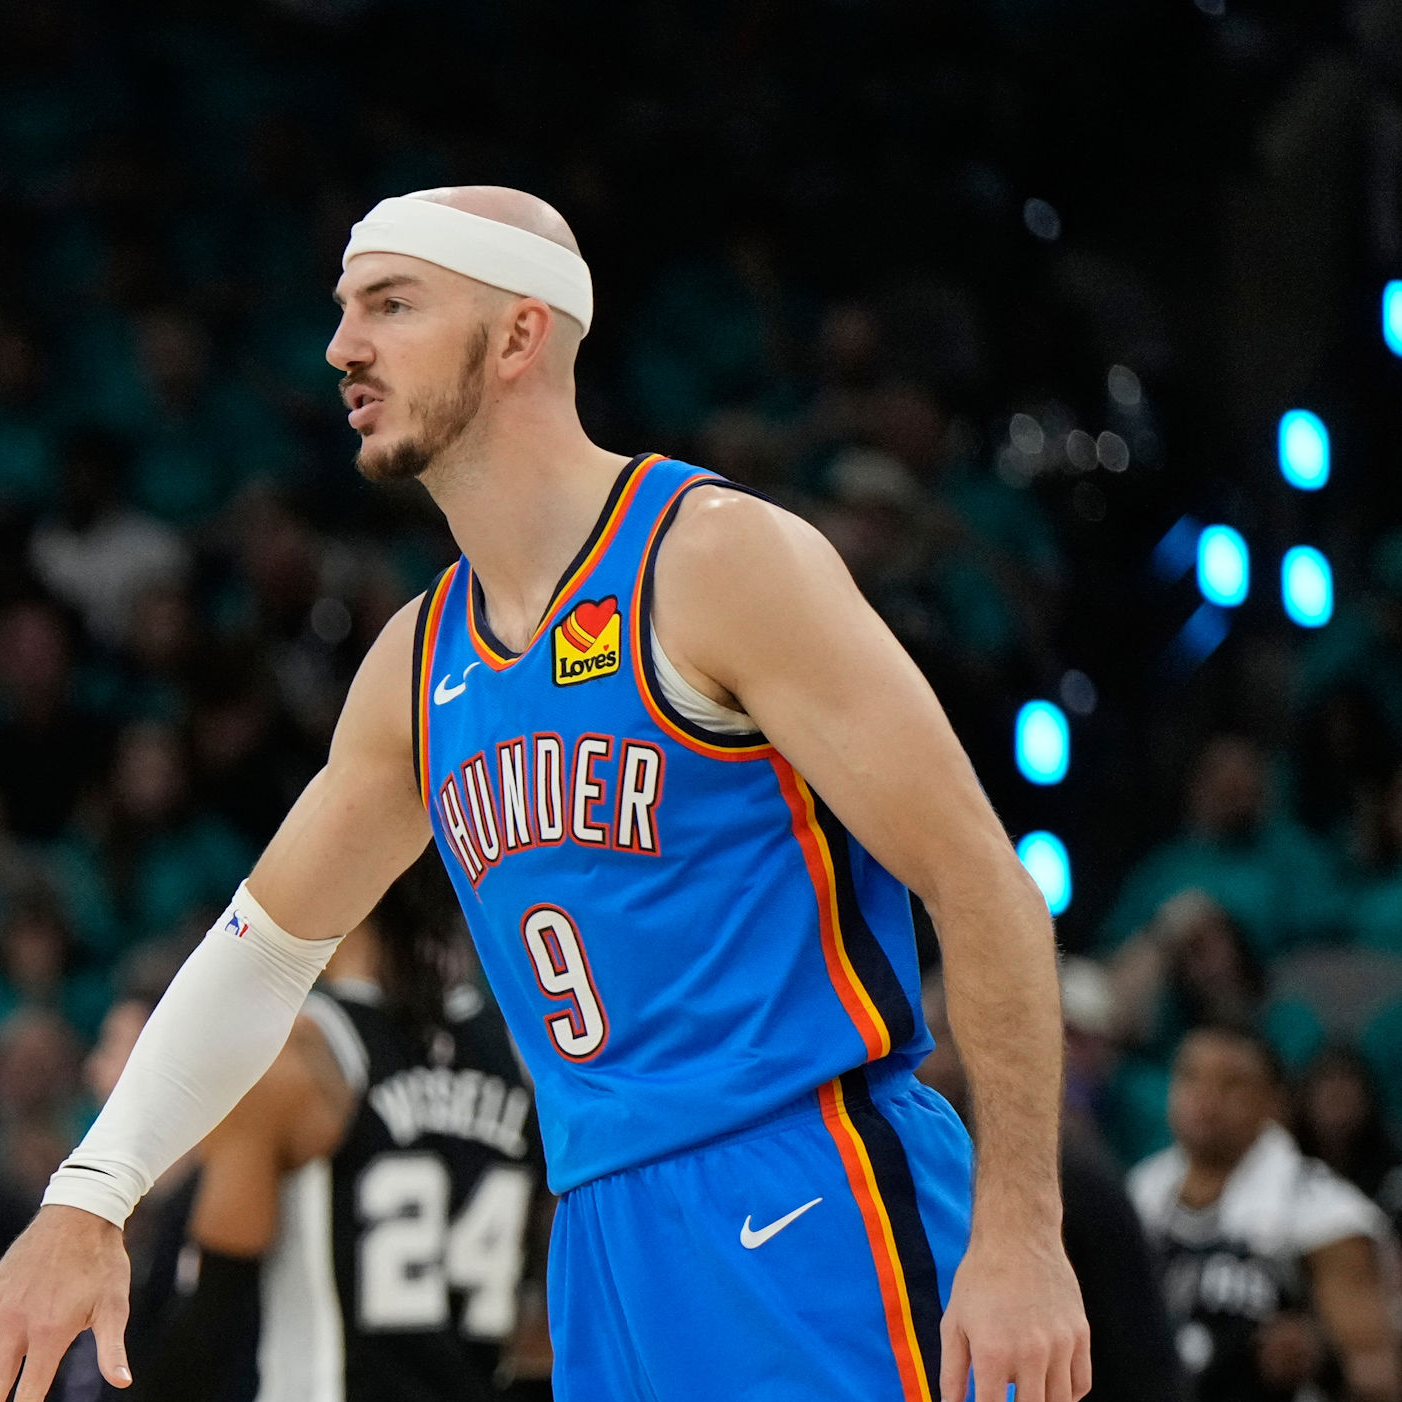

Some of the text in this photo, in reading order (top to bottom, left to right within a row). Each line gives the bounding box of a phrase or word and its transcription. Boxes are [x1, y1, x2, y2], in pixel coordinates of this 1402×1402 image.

[434, 732, 664, 890] HUNDER
[519, 902, 610, 1064] 9
[357, 1151, 532, 1340] 24
